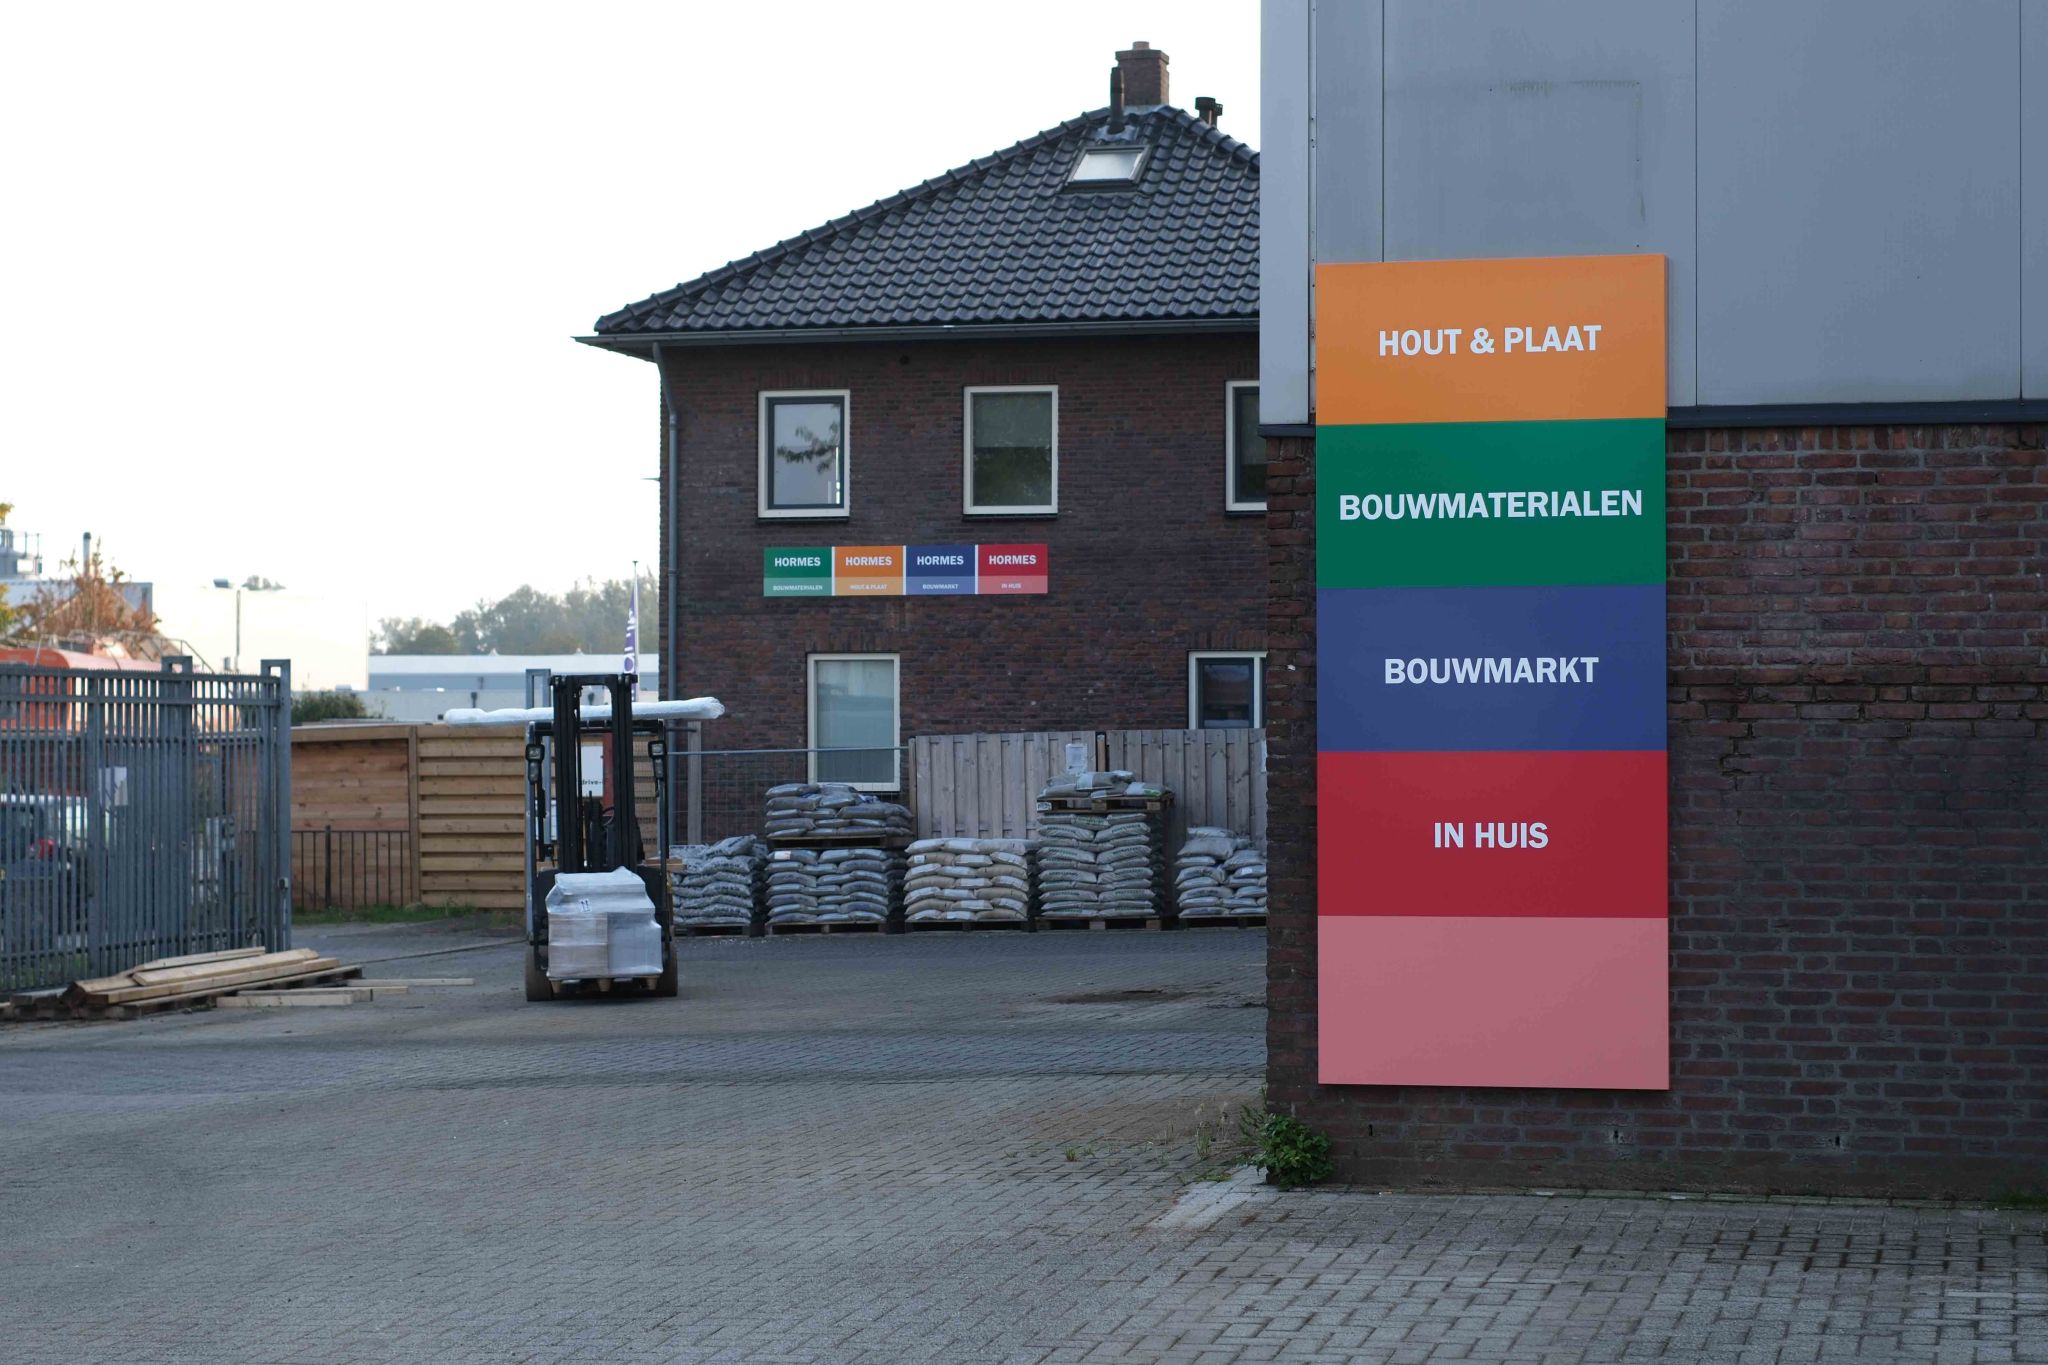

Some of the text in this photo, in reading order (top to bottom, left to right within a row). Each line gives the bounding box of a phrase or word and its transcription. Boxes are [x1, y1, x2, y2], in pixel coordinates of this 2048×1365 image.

[1379, 324, 1602, 357] HOUT & PLAAT
[1339, 489, 1642, 521] BOUWMATERIALEN
[774, 556, 821, 567] HORMES
[845, 556, 893, 566] HORMES
[916, 555, 964, 566] HORMES
[988, 554, 1037, 565] HORMES
[1385, 656, 1599, 685] BOUWMARKT
[1434, 822, 1549, 849] IN HUIS
